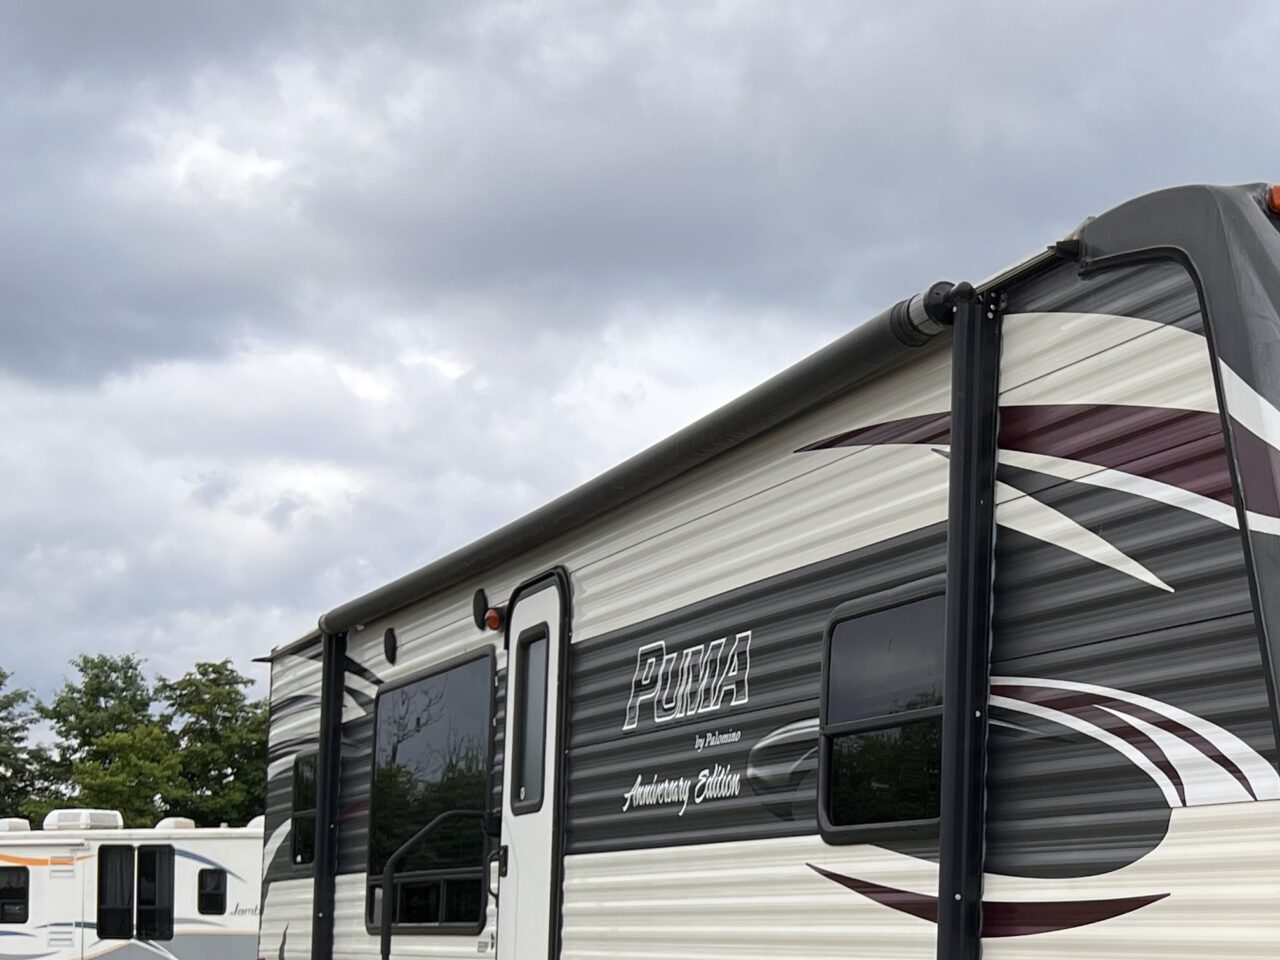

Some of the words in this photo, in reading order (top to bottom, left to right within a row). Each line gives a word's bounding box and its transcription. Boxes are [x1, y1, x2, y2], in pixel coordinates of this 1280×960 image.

[622, 630, 752, 730] PUMA
[695, 734, 705, 752] by
[705, 728, 741, 747] Palomino
[622, 774, 691, 817] Anniversary
[694, 763, 740, 804] Edition
